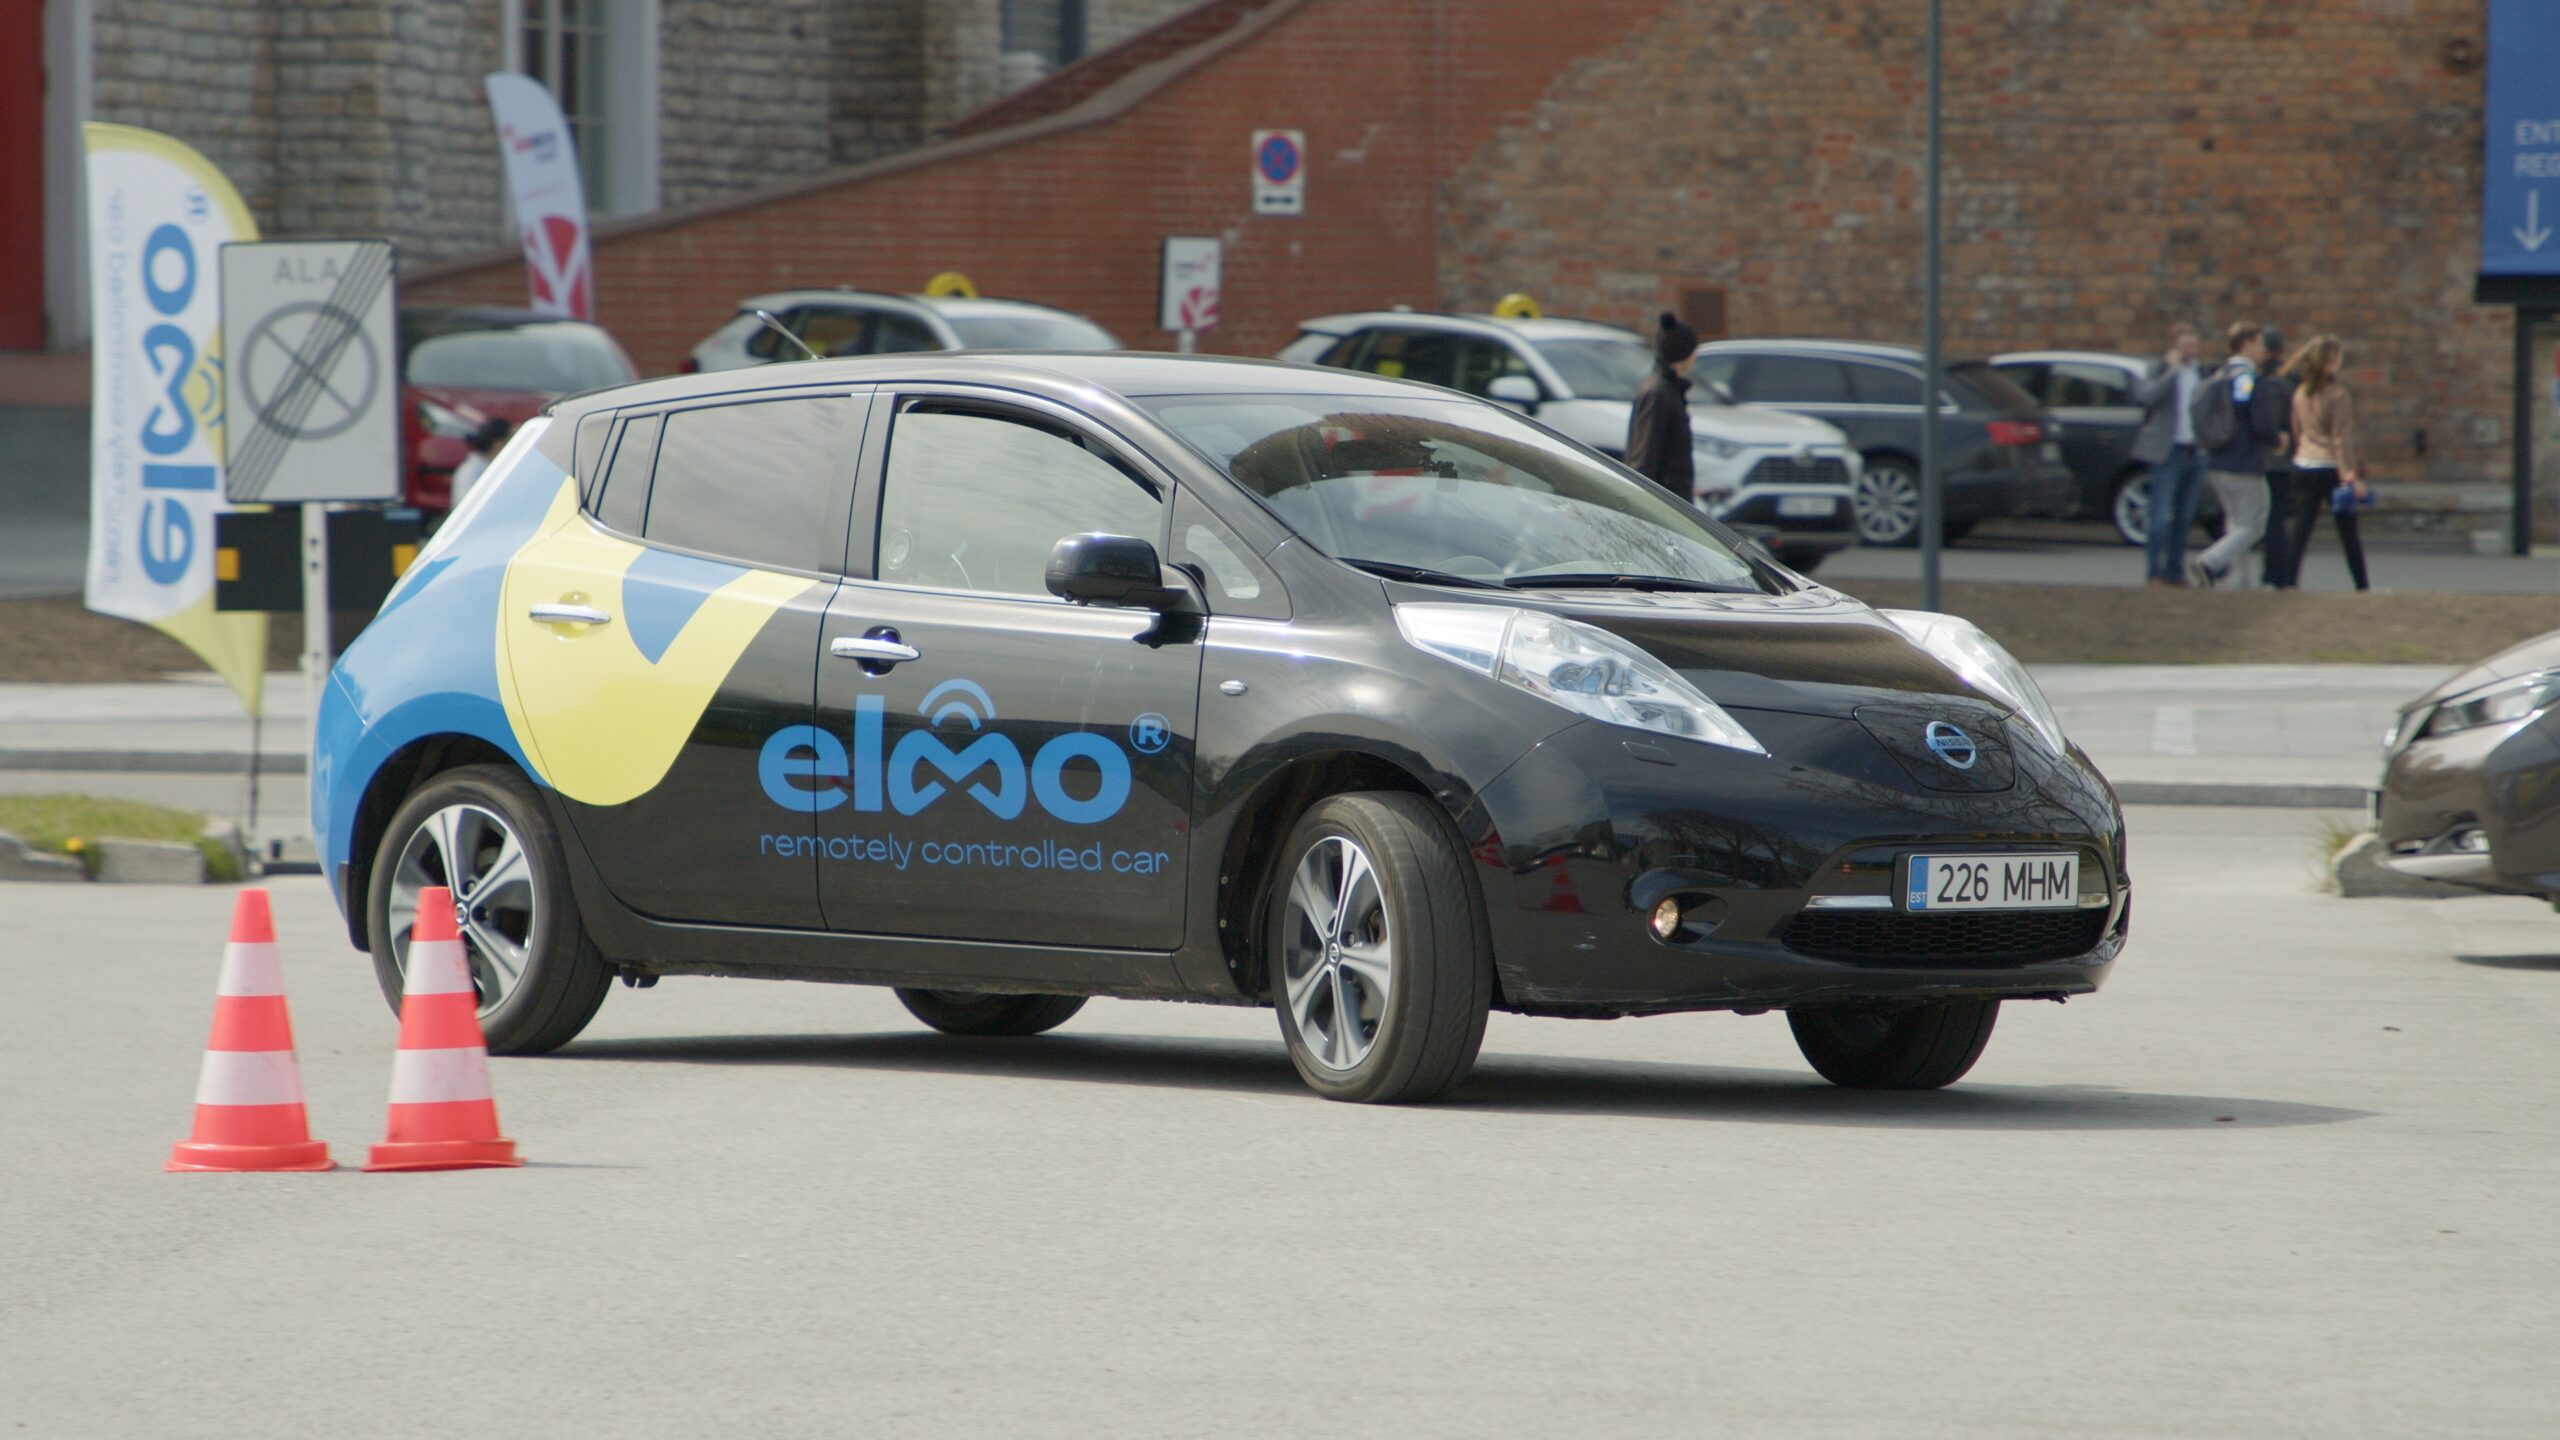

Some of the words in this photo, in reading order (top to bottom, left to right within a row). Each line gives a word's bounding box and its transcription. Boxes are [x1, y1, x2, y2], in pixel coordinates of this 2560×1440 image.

[273, 257, 341, 283] ALA
[758, 694, 1132, 824] elmo
[760, 832, 913, 870] remotely
[921, 839, 1102, 871] controlled
[1112, 849, 1169, 873] car
[1910, 892, 1927, 903] EST
[1937, 863, 1989, 902] 226
[2004, 861, 2070, 901] MHM
